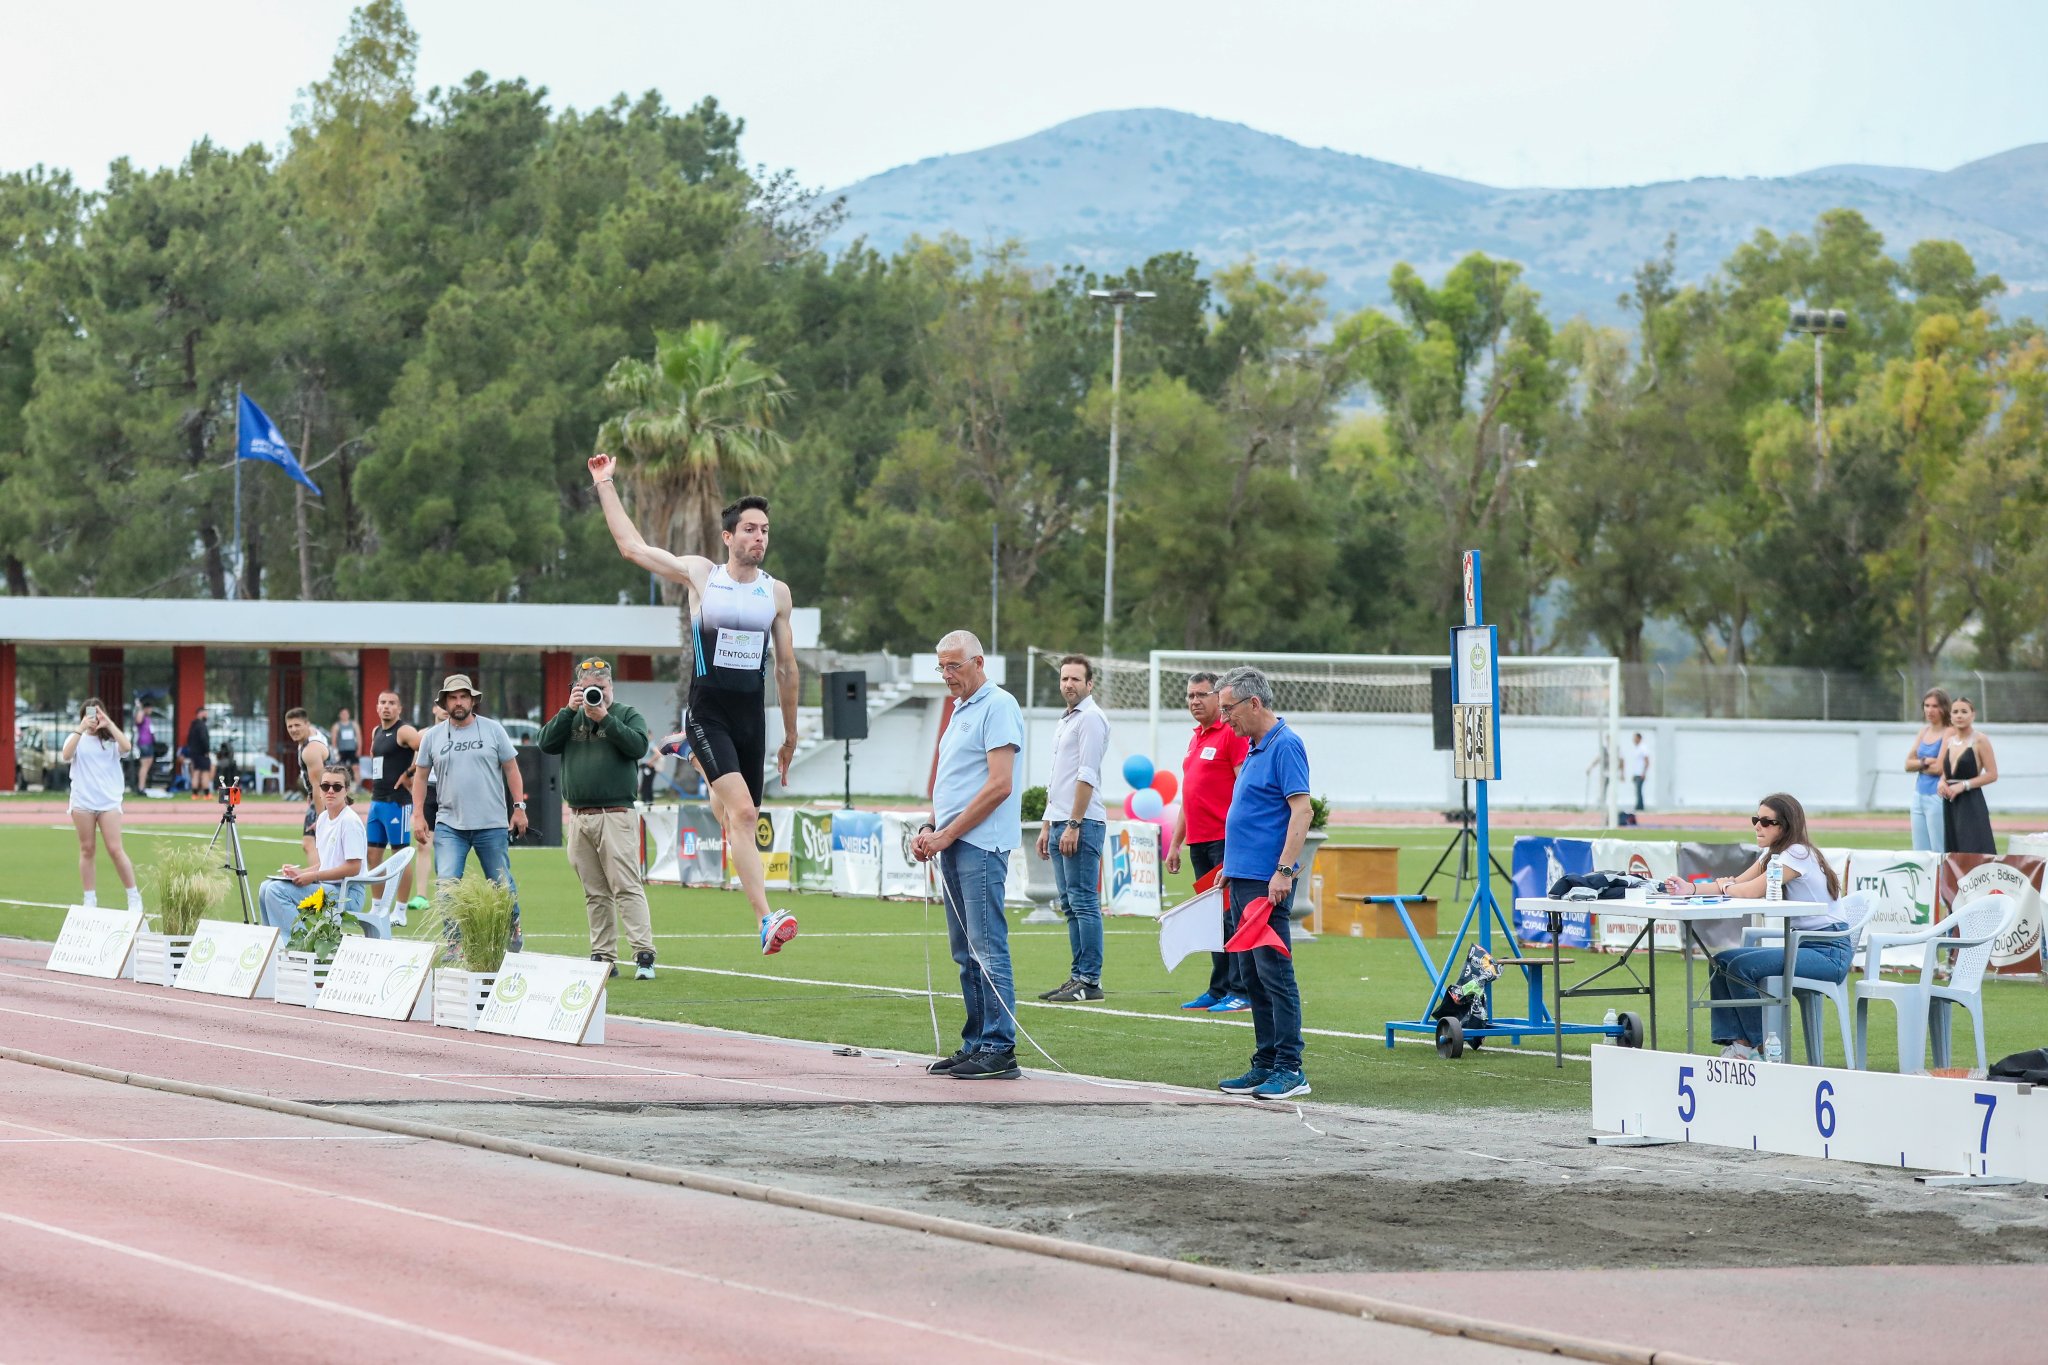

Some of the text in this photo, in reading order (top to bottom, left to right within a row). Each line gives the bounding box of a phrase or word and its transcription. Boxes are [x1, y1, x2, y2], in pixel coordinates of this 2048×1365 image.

[718, 649, 761, 659] TENTOGLOU
[454, 740, 484, 752] asics
[1998, 869, 2024, 889] Bakery
[337, 949, 395, 968] ΓΥΜΝΑΣΤΙΚΗ
[329, 967, 370, 986] ΕΤΑΙΡΕΙΑ
[1706, 1059, 1757, 1087] 3STARS
[1677, 1066, 1696, 1123] 5
[1815, 1080, 1836, 1139] 6
[1974, 1092, 1997, 1154] 7
